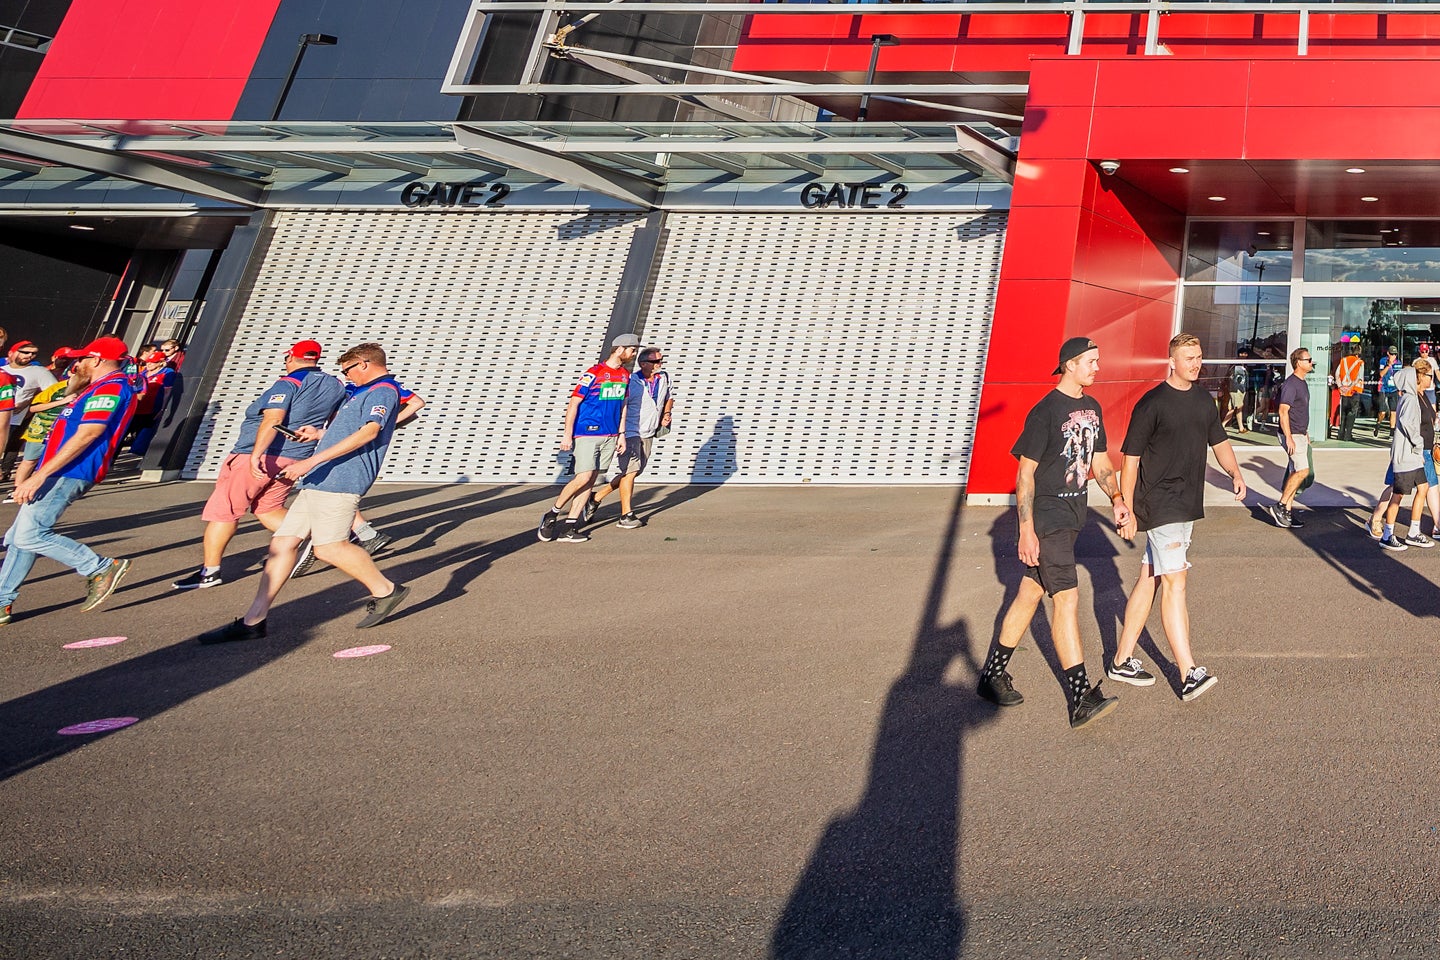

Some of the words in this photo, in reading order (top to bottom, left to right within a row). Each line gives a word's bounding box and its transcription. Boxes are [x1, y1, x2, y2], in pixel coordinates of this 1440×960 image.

[400, 181, 487, 208] GATE
[484, 182, 511, 208] 2
[800, 182, 883, 209] GATE
[886, 182, 909, 209] 2
[601, 384, 626, 399] nib
[85, 397, 116, 410] nib
